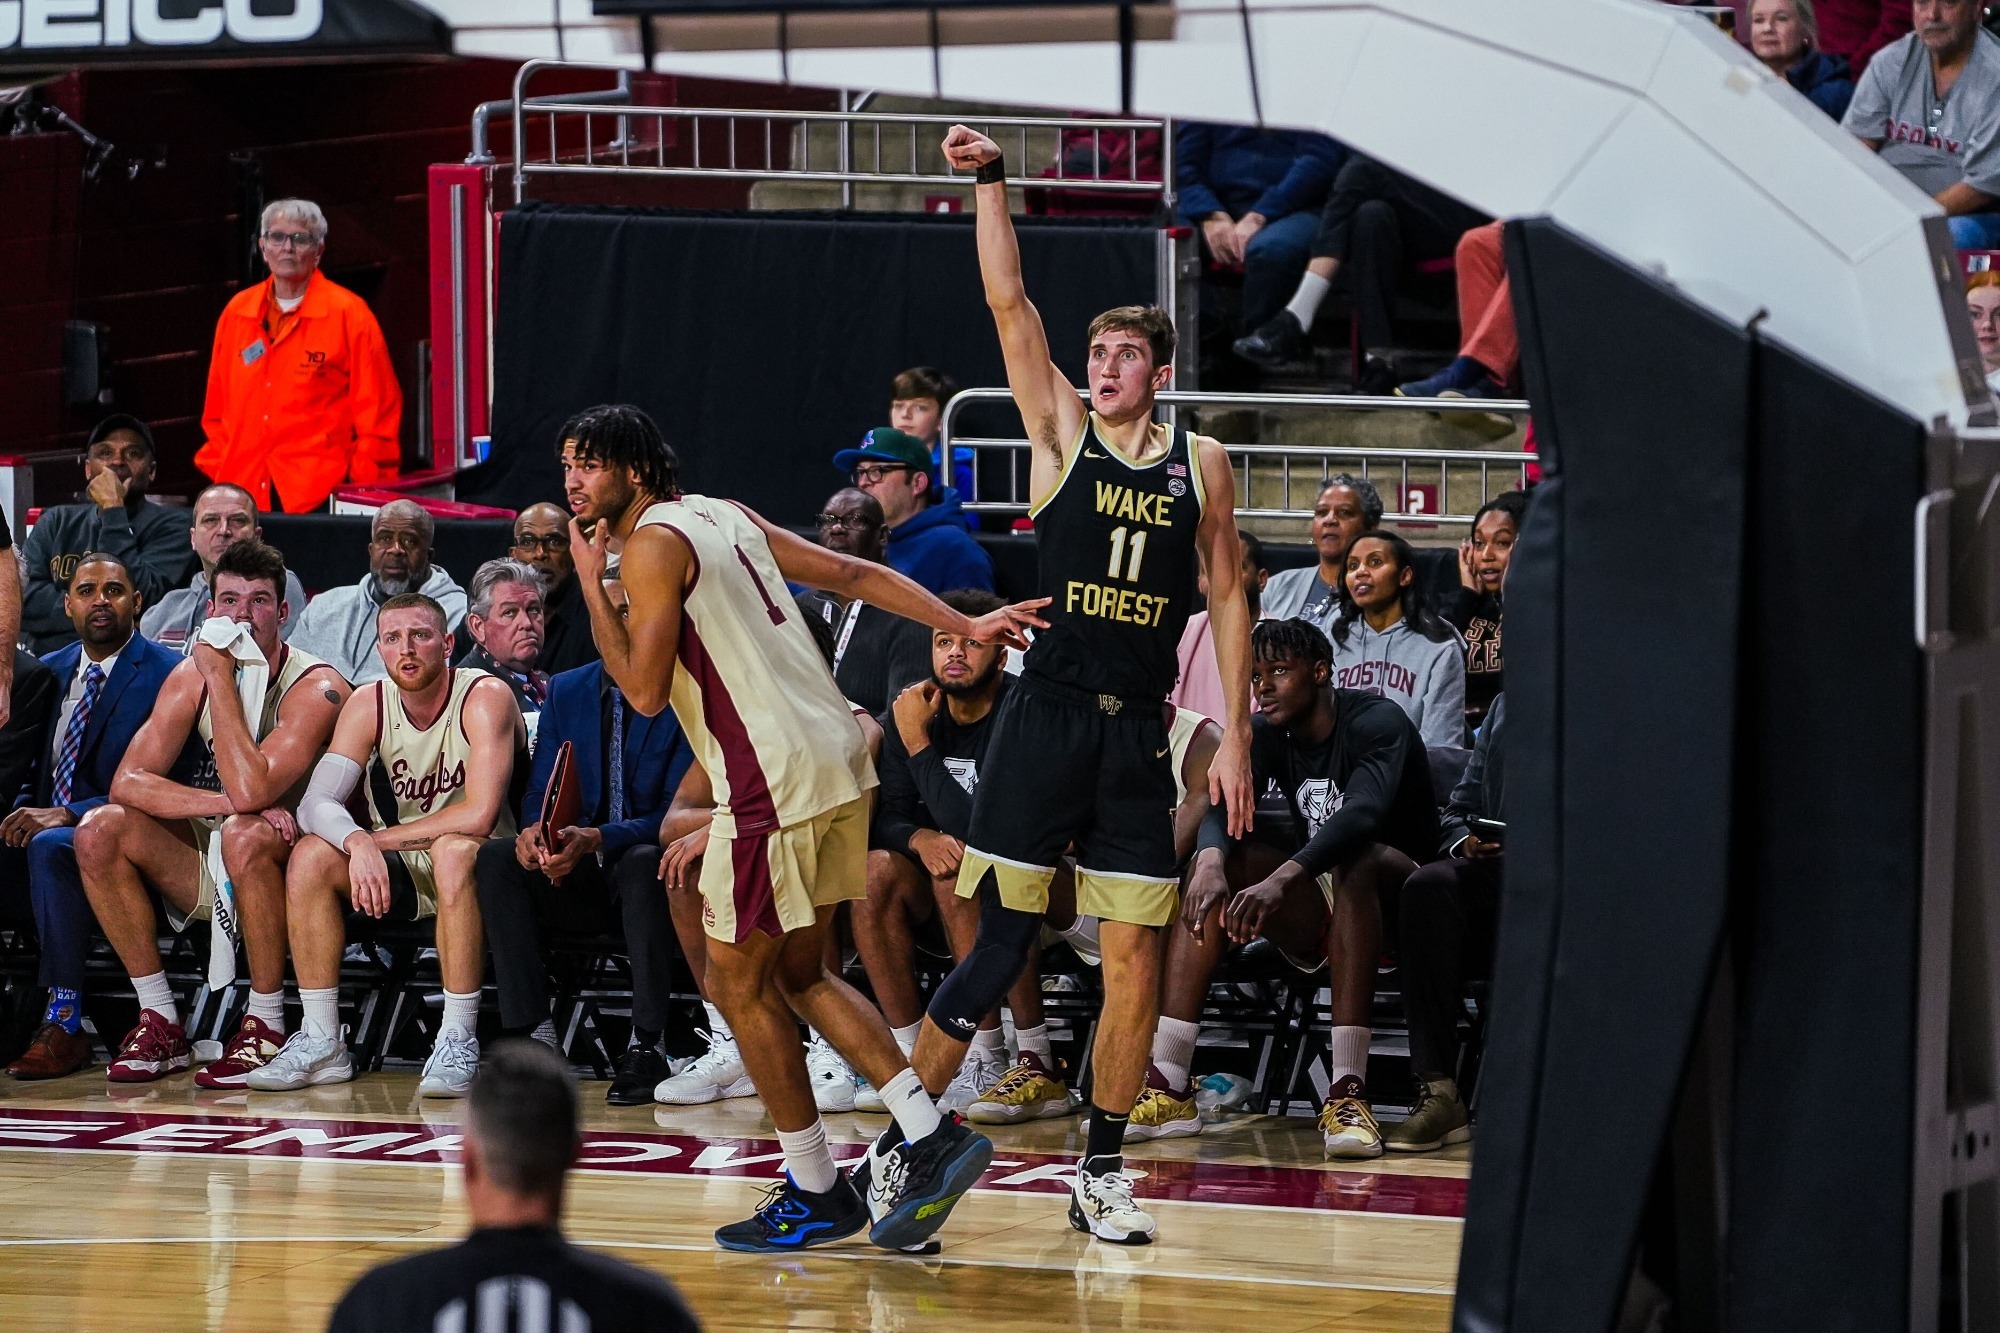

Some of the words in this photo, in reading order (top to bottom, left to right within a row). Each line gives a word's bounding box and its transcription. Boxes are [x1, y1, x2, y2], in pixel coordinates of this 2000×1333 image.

[0, 0, 323, 48] EICO
[1096, 480, 1174, 526] WAKE
[1108, 526, 1147, 582] 11
[734, 544, 787, 626] 1
[1066, 580, 1169, 627] FOREST
[1338, 660, 1417, 698] BOSTON
[391, 752, 466, 814] Eagles
